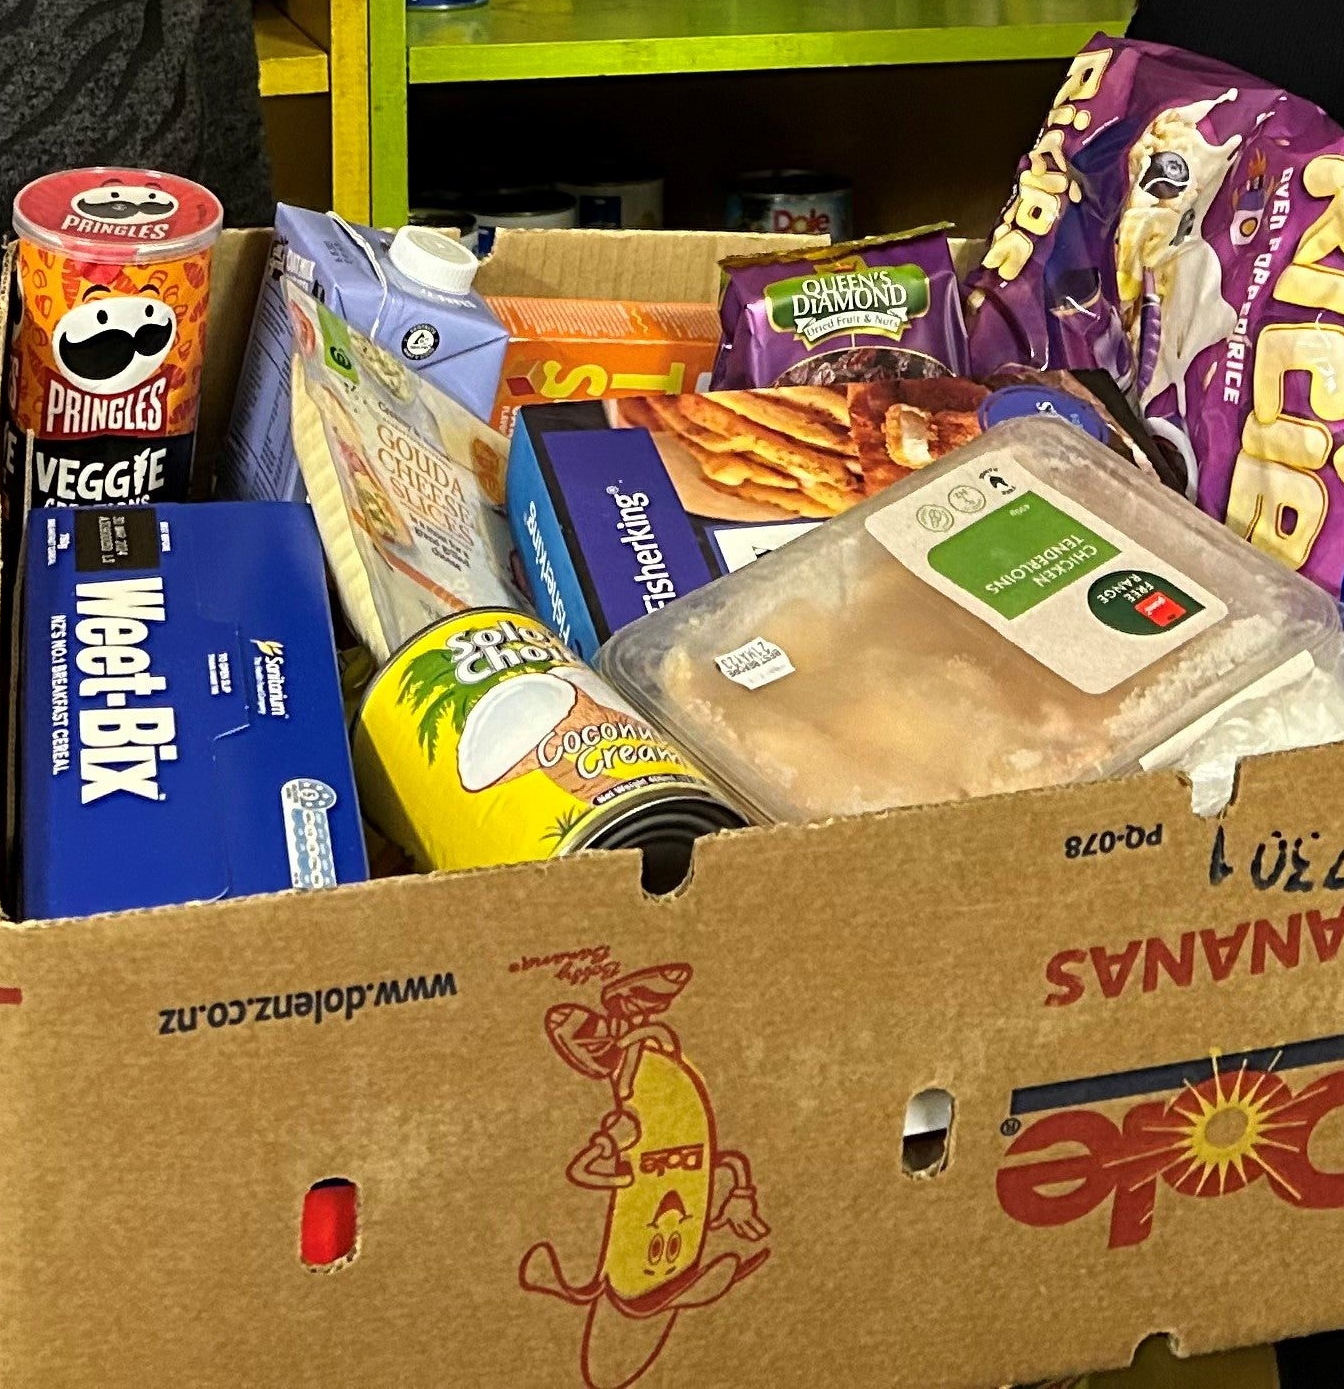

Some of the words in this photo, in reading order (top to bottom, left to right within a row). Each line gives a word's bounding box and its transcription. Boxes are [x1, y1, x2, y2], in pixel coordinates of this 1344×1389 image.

[60, 214, 170, 241] PRINGLES
[773, 208, 831, 233] Dole
[1264, 167, 1295, 236] OVEN
[801, 270, 893, 300] QUEEN'S
[806, 318, 835, 338] Dried
[836, 314, 861, 329] Fruit
[863, 313, 873, 324] &
[874, 314, 899, 329] Nuts
[1223, 336, 1250, 406] RICE
[46, 376, 168, 436] PRINGLES
[34, 447, 168, 502] VEGGIE
[376, 423, 466, 504] GOUDA
[378, 447, 476, 531] CHEESE
[617, 490, 674, 616] Fisherking
[985, 532, 1086, 595] TENDERLOINS
[1032, 543, 1099, 589] CHICKEN
[1095, 570, 1146, 606] RANGE
[1120, 580, 1155, 606] FREE
[51, 665, 69, 727] BREAKFAST
[75, 576, 178, 805] Weet-Bix
[265, 655, 289, 716] Sanitarium
[52, 728, 70, 776] CEREAL
[1063, 821, 1164, 860] PQ-078
[157, 970, 458, 1038] www.dolenz.co.nz
[640, 1142, 704, 1177] Dole
